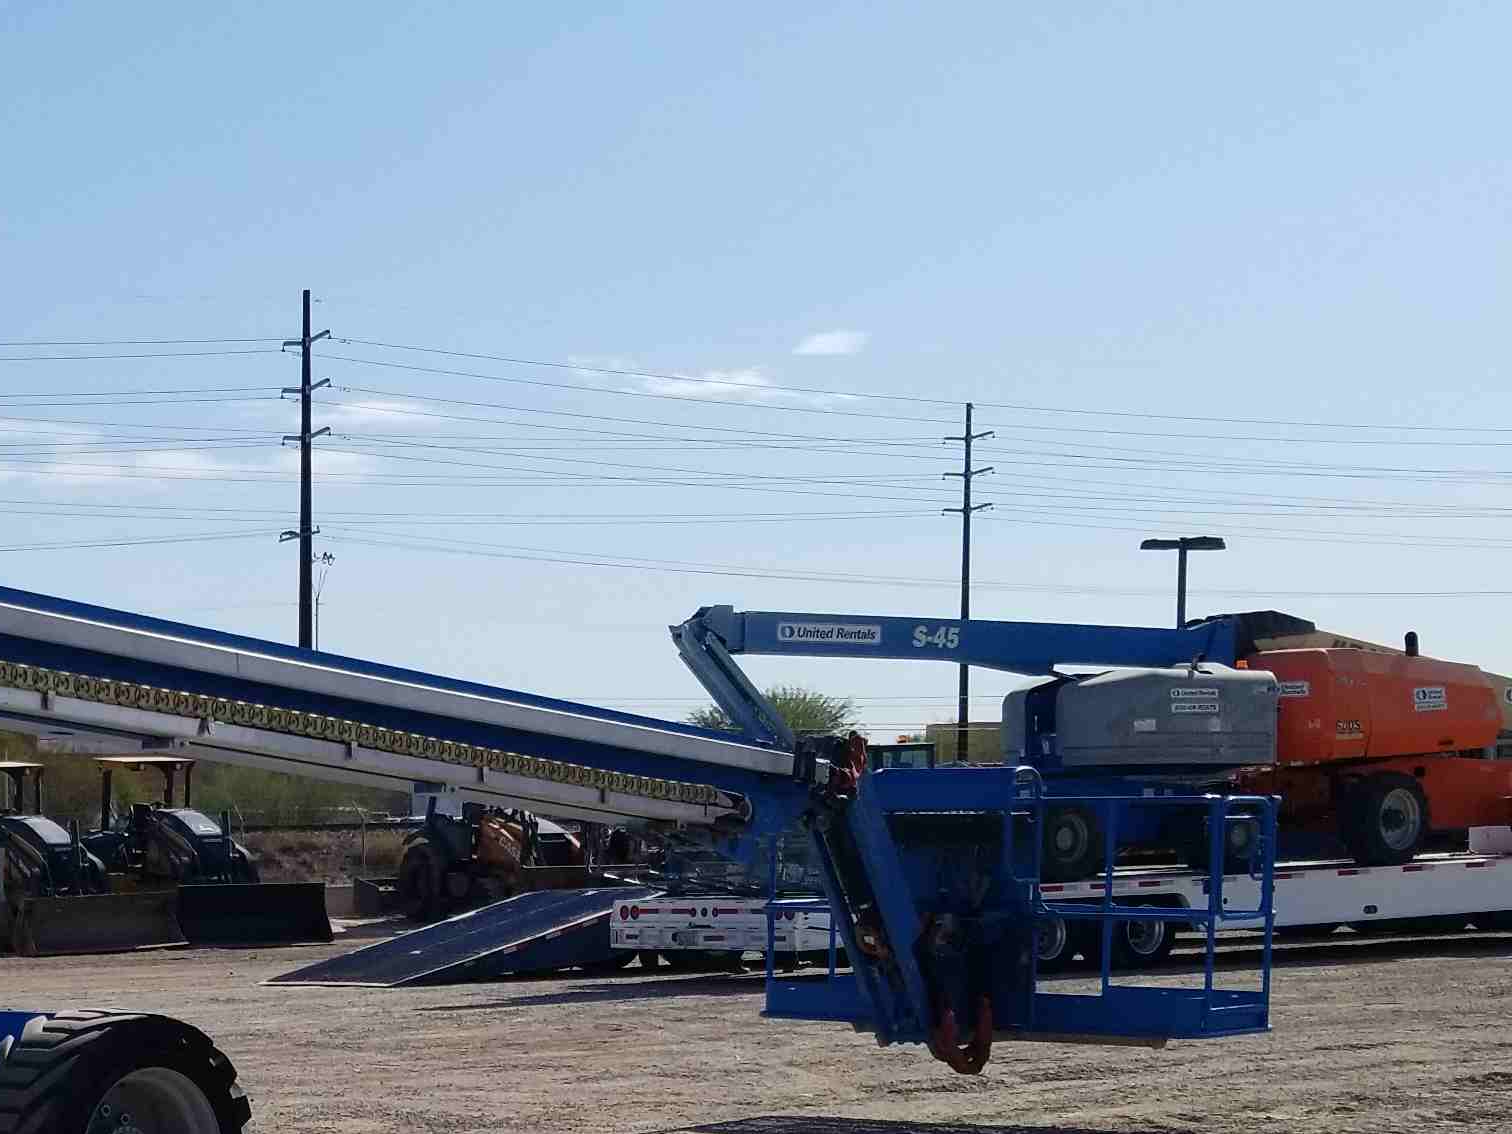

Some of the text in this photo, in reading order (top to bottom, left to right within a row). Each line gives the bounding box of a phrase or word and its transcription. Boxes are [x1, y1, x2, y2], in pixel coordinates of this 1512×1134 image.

[797, 628, 876, 641] United Rentals
[912, 625, 961, 649] S-45
